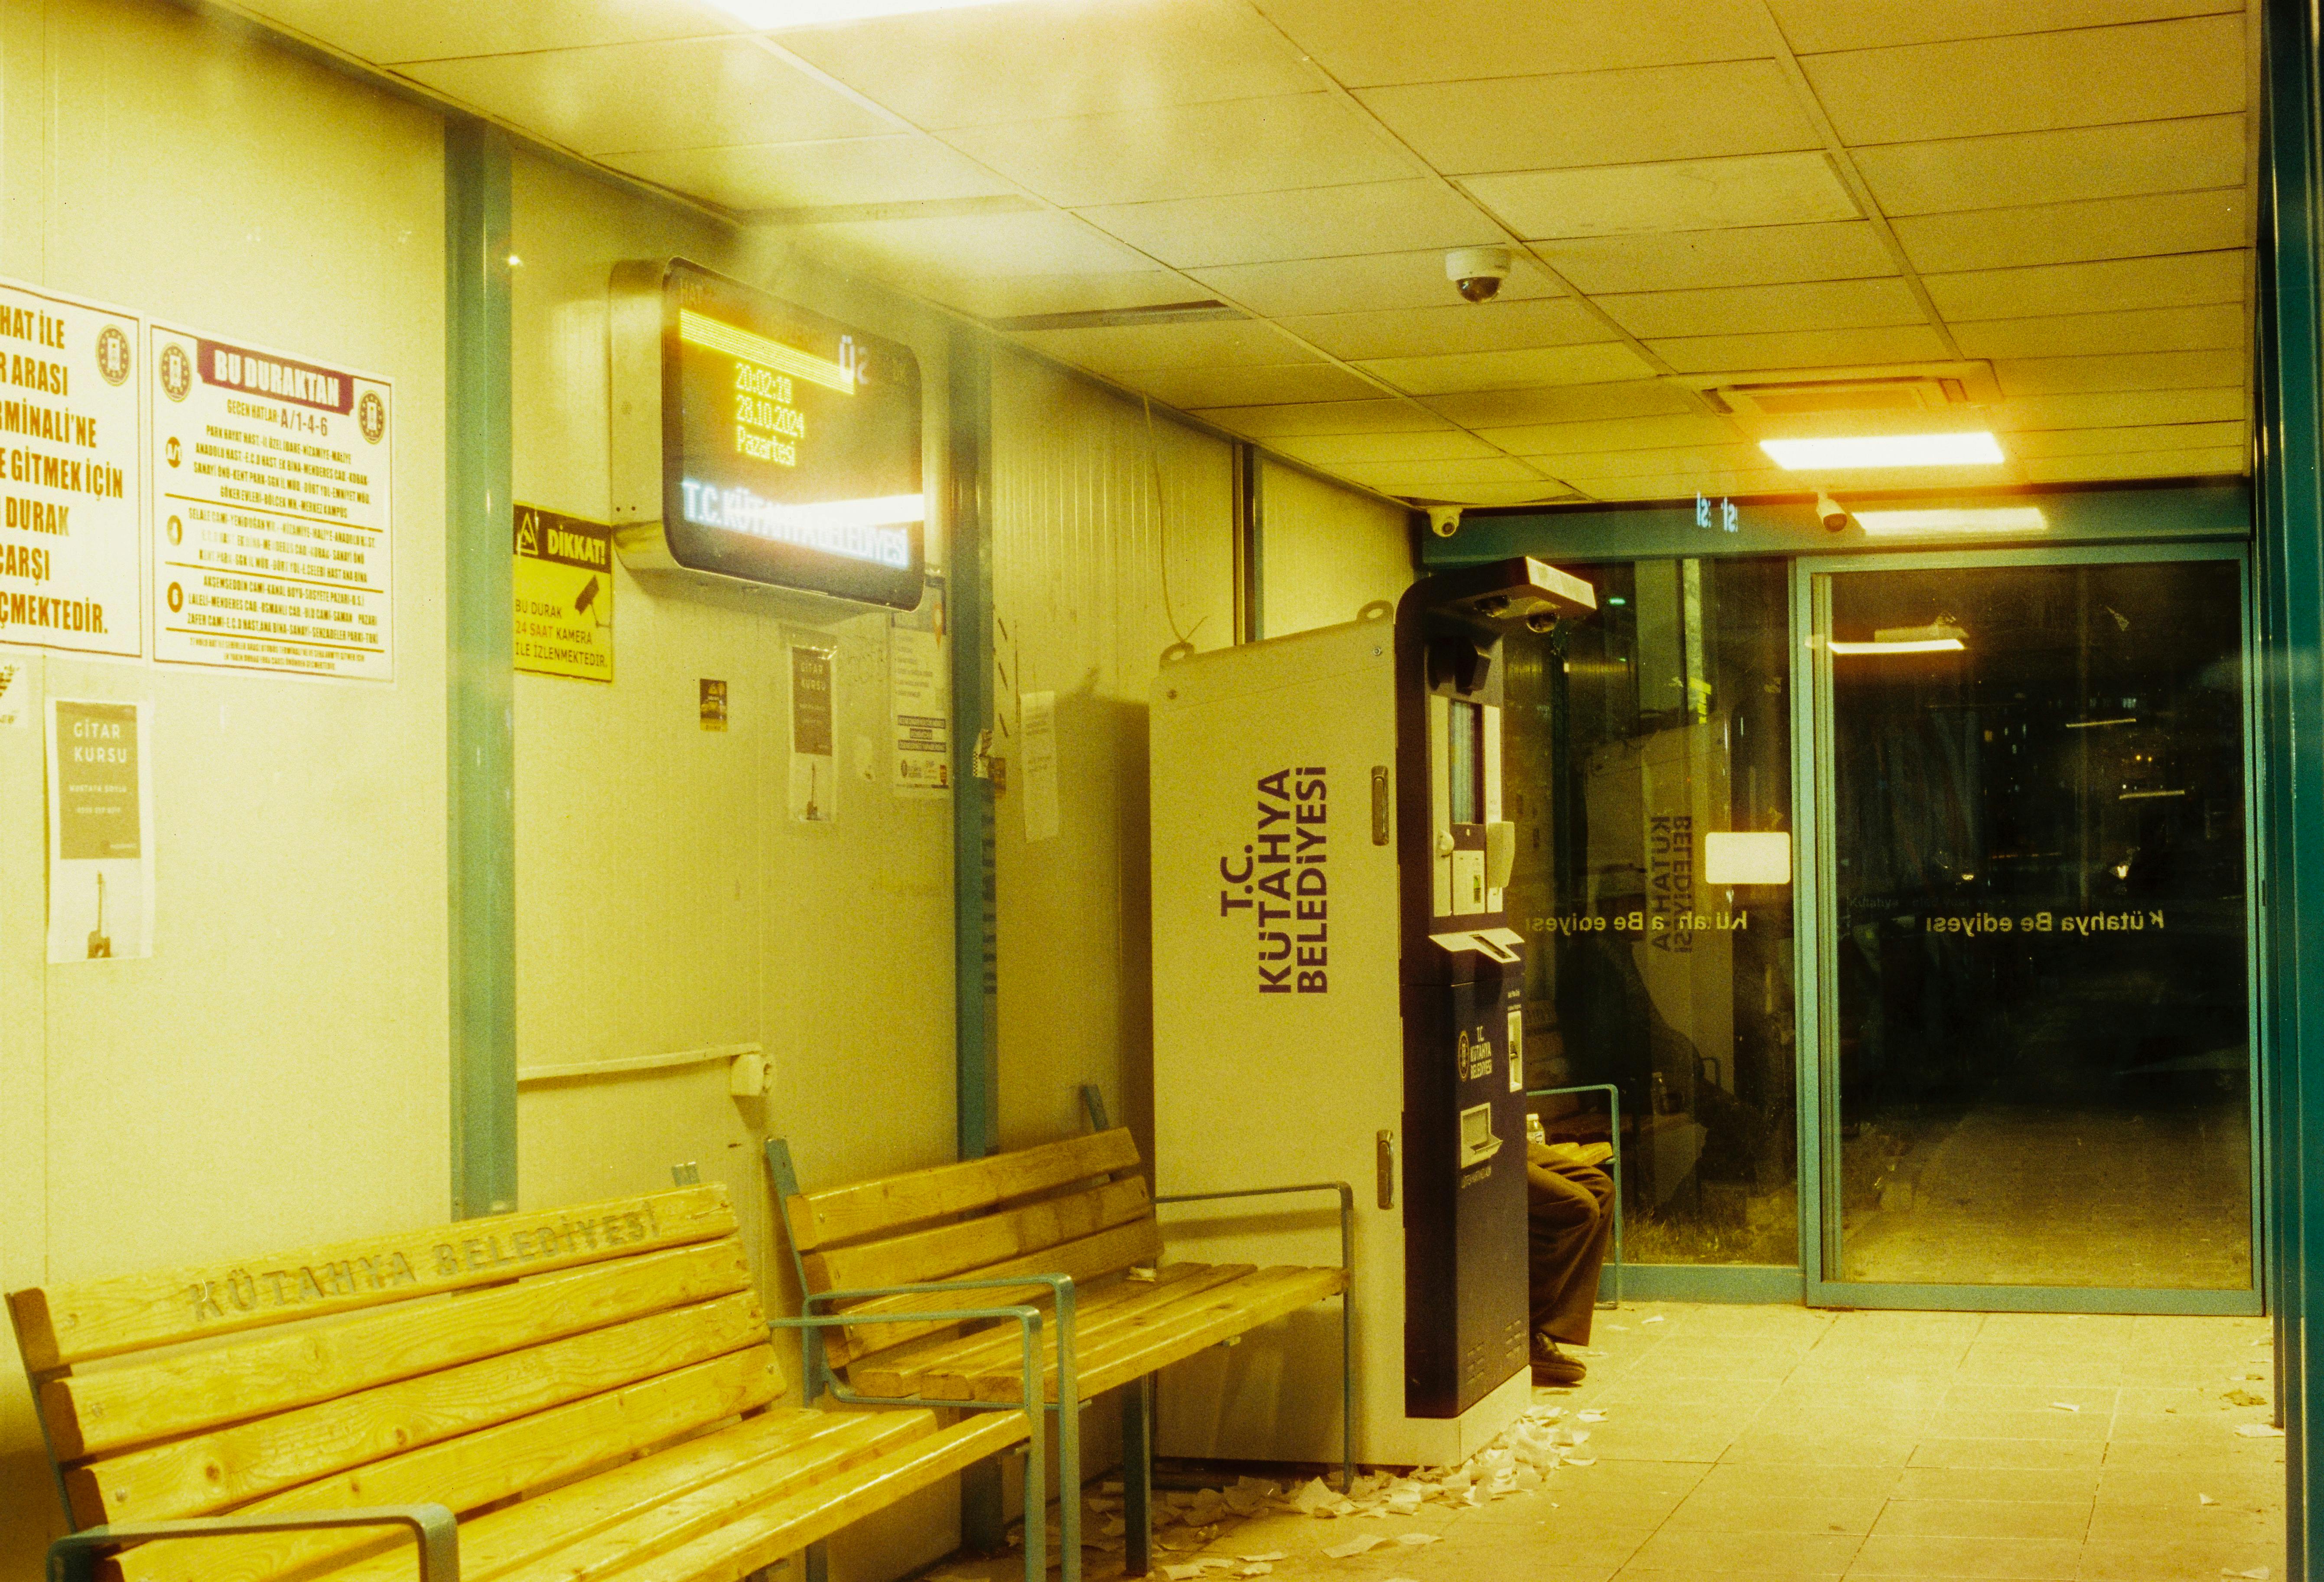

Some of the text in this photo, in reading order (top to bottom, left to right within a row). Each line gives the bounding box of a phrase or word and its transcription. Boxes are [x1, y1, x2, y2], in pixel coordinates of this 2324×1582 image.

[39, 310, 65, 349] İLE
[11, 355, 68, 396] ARASI
[215, 350, 339, 407] BU DURAKTAN
[0, 398, 96, 448] MİNALİ'NE
[281, 408, 327, 436] A/1-4-6
[736, 395, 805, 438] 28.10.2024
[737, 425, 796, 466] Pazartesi
[11, 446, 81, 492] GİTMEK
[86, 459, 123, 501] İÇİN
[6, 496, 70, 536] DURAK
[547, 525, 605, 565] DİKKAT!
[515, 599, 562, 619] BU DURAK
[515, 621, 592, 645] 24 SAAT KAMERA
[74, 718, 120, 739] GİTAR
[75, 746, 127, 763] KURSU
[1220, 844, 1253, 917] T.C.
[1258, 768, 1291, 993] KÜTAHYA
[1295, 767, 1328, 994] BELEDİYESİ
[1470, 1041, 1491, 1063] KÜTAHYA
[189, 1201, 661, 1321] KÜTAHYA BELEDİYESİ
